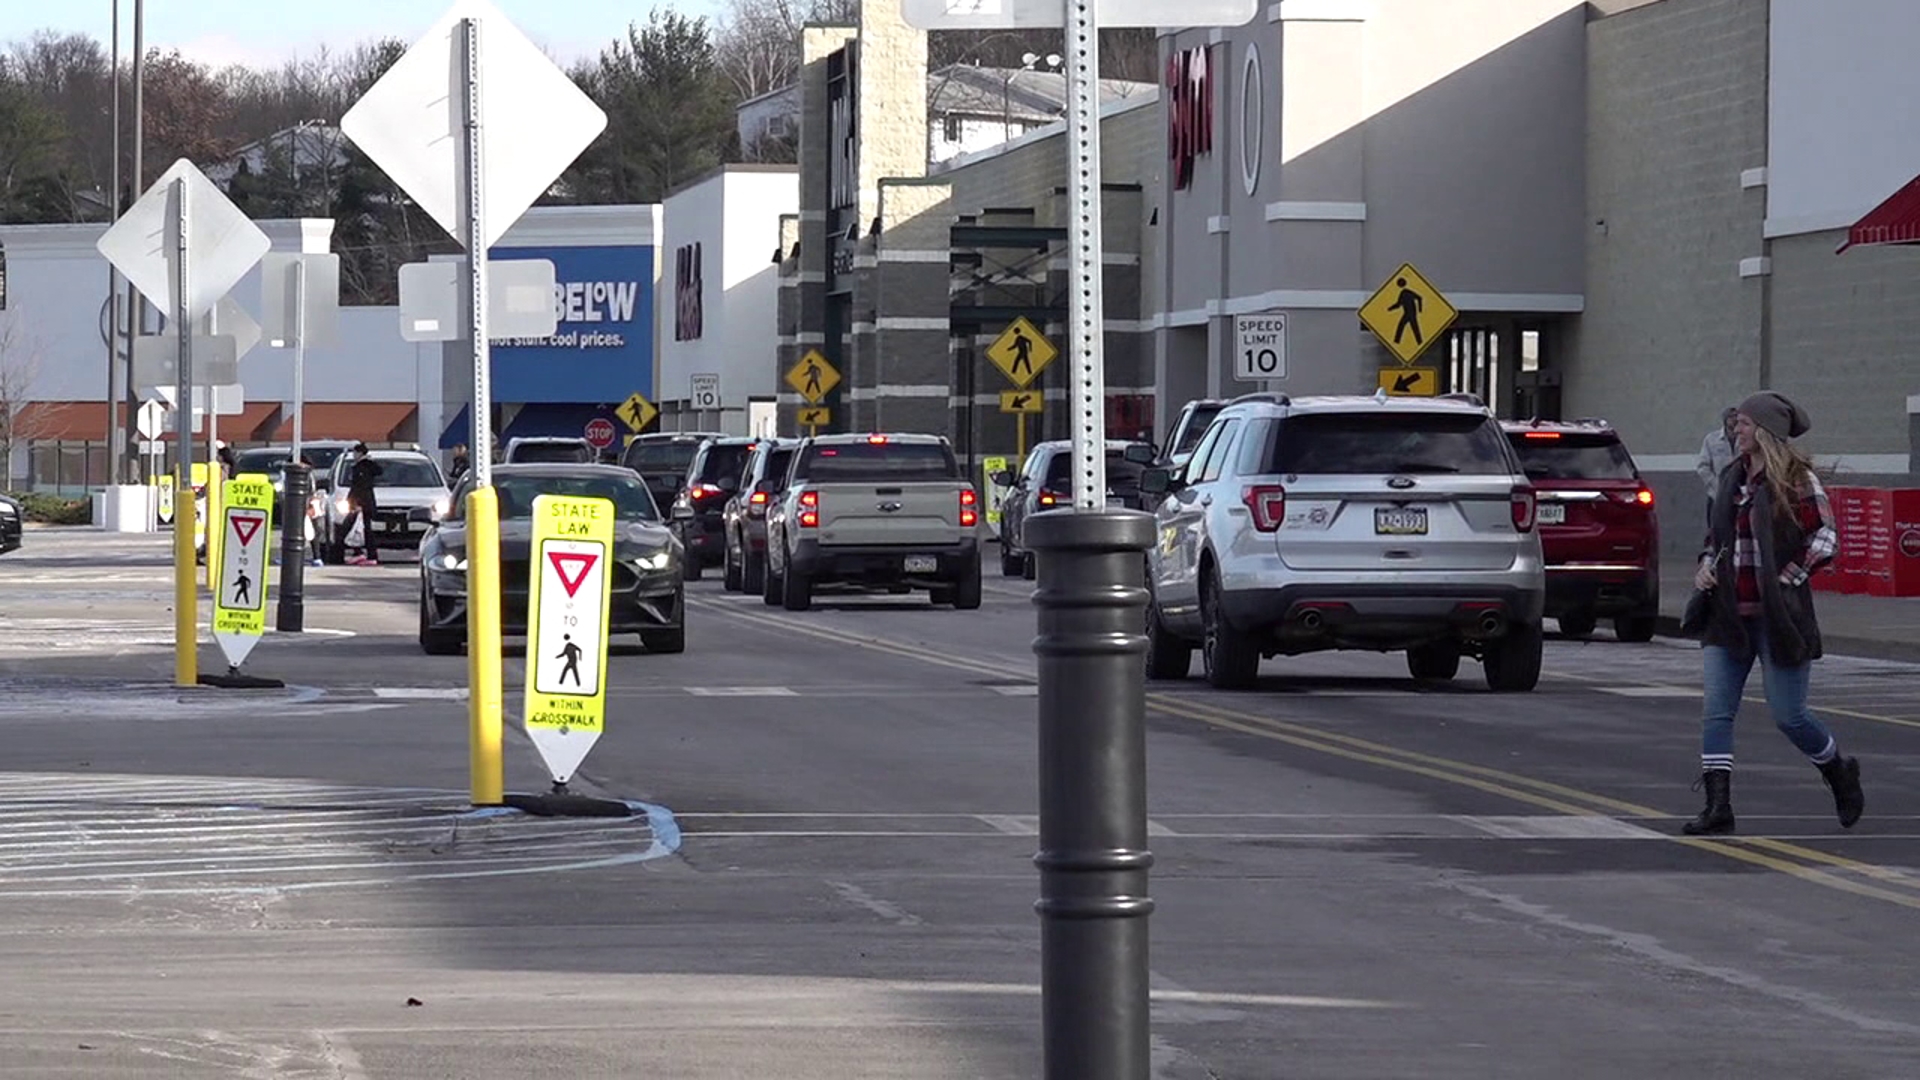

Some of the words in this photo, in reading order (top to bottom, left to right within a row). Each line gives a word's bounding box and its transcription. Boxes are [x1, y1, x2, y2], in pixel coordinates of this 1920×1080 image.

[1239, 320, 1283, 332] SPEED
[550, 331, 577, 347] cool
[580, 330, 625, 350] prices.
[1243, 334, 1278, 346] LIMIT
[1244, 348, 1278, 374] 10
[696, 392, 715, 406] 10
[587, 427, 613, 440] STOP
[231, 484, 264, 496] STATE
[236, 496, 258, 506] LAW
[551, 503, 601, 520] STATE
[557, 522, 591, 535] LAW
[563, 615, 578, 627] TO
[531, 711, 596, 726] CROSSWALK
